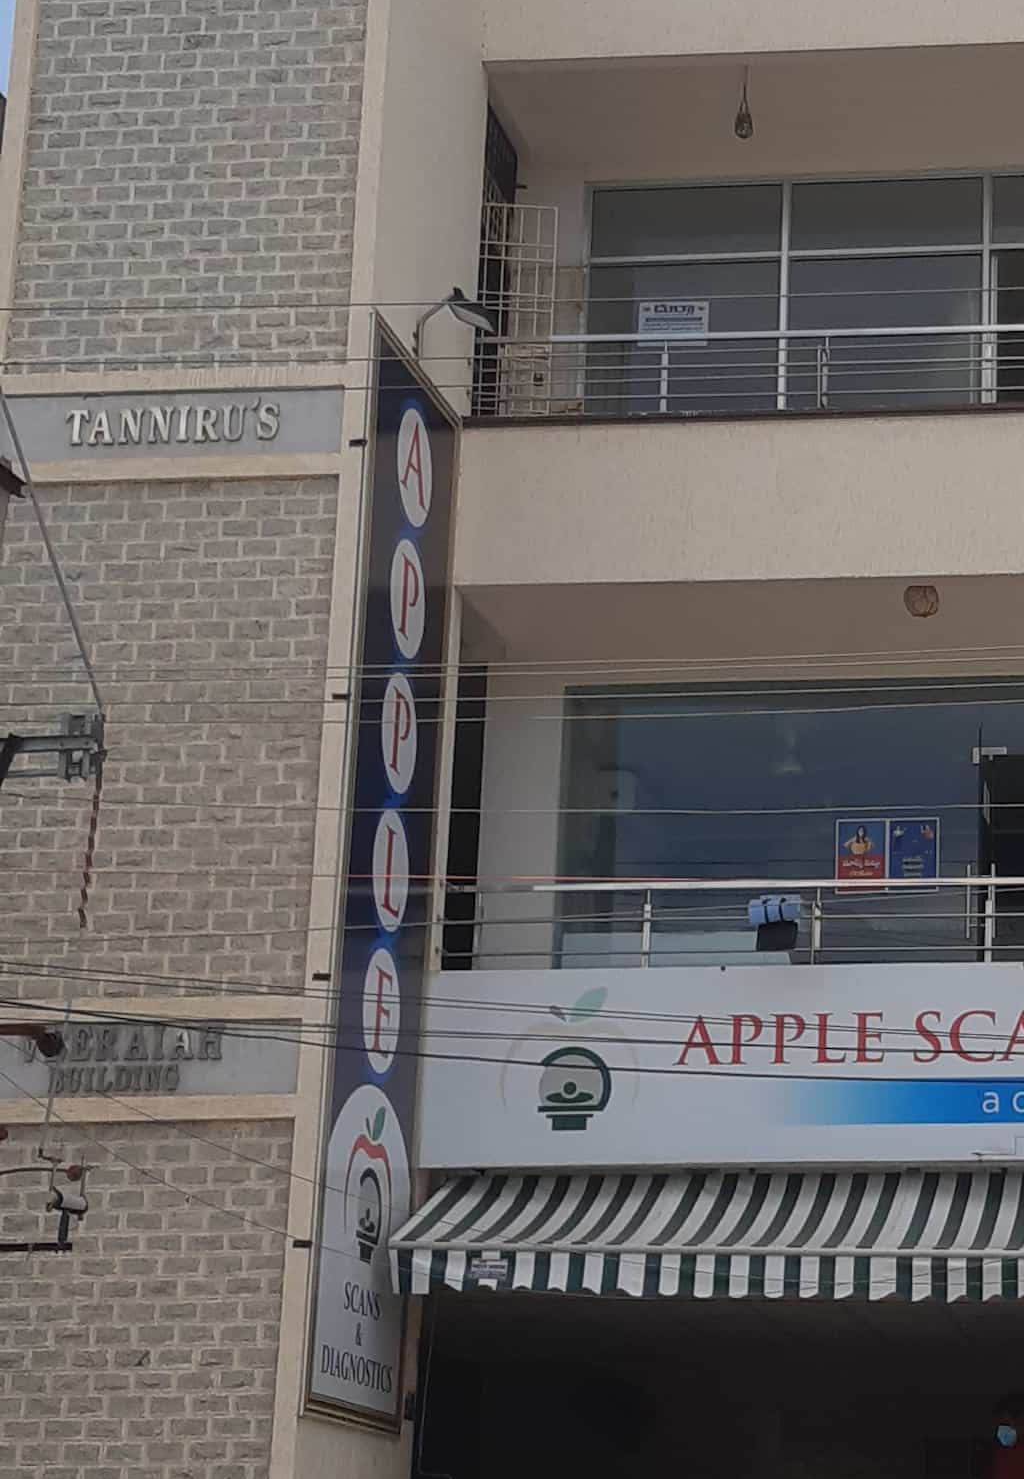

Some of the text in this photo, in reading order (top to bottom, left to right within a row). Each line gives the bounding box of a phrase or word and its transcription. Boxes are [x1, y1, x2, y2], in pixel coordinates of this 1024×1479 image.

[66, 396, 280, 447] TANNIRU'S
[673, 1010, 886, 1067] APPLE
[49, 1065, 180, 1093] BUILDING
[982, 1091, 999, 1114] a
[344, 1281, 381, 1321] SCANS
[321, 1344, 393, 1393] DIAGNOSTICS
